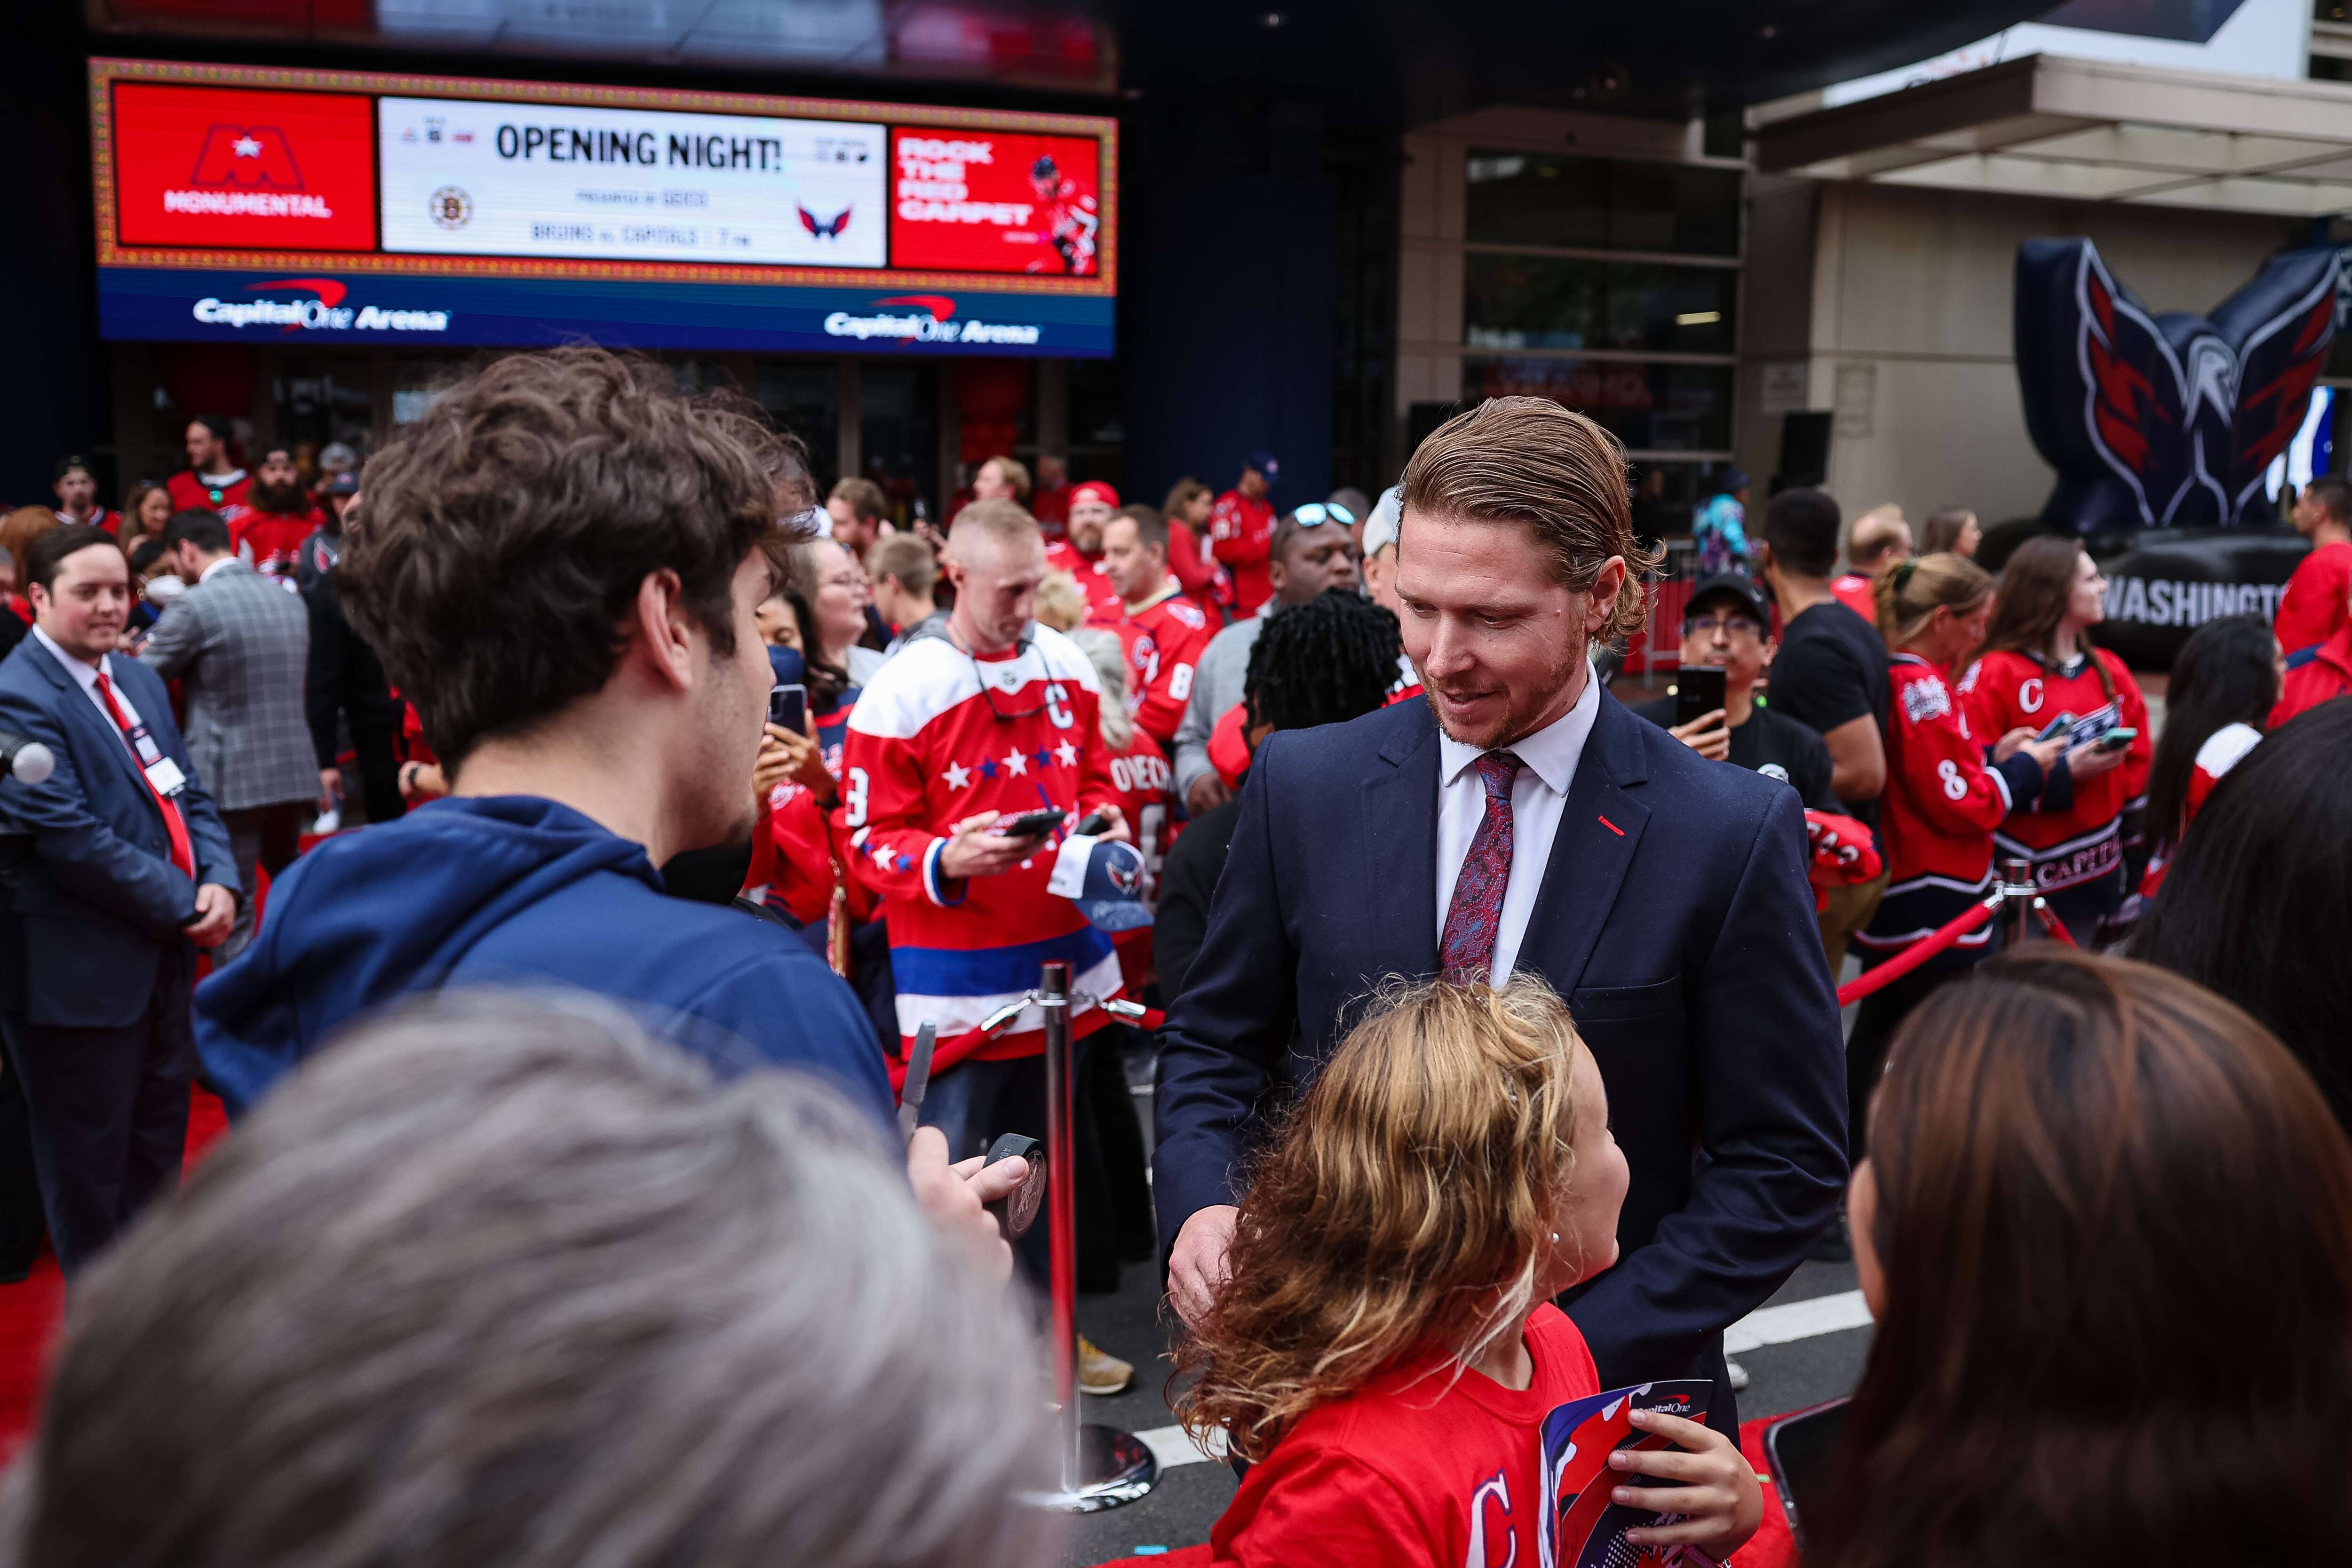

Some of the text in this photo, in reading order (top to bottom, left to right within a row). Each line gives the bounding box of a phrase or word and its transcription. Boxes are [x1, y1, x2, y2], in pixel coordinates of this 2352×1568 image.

[497, 124, 782, 172] OPENING NIGHT!
[898, 137, 994, 164] ROCK
[898, 160, 965, 181] THE
[164, 189, 333, 219] MONUMENTAL
[898, 181, 969, 201] RED
[898, 200, 1033, 226] CARPET
[354, 305, 447, 330] Arena
[960, 320, 1039, 344] Arena
[1168, 662, 1195, 700] 8
[2018, 678, 2044, 714] C
[1044, 683, 1074, 729] C
[1938, 759, 1968, 800] 8
[1465, 1467, 1518, 1568] C
